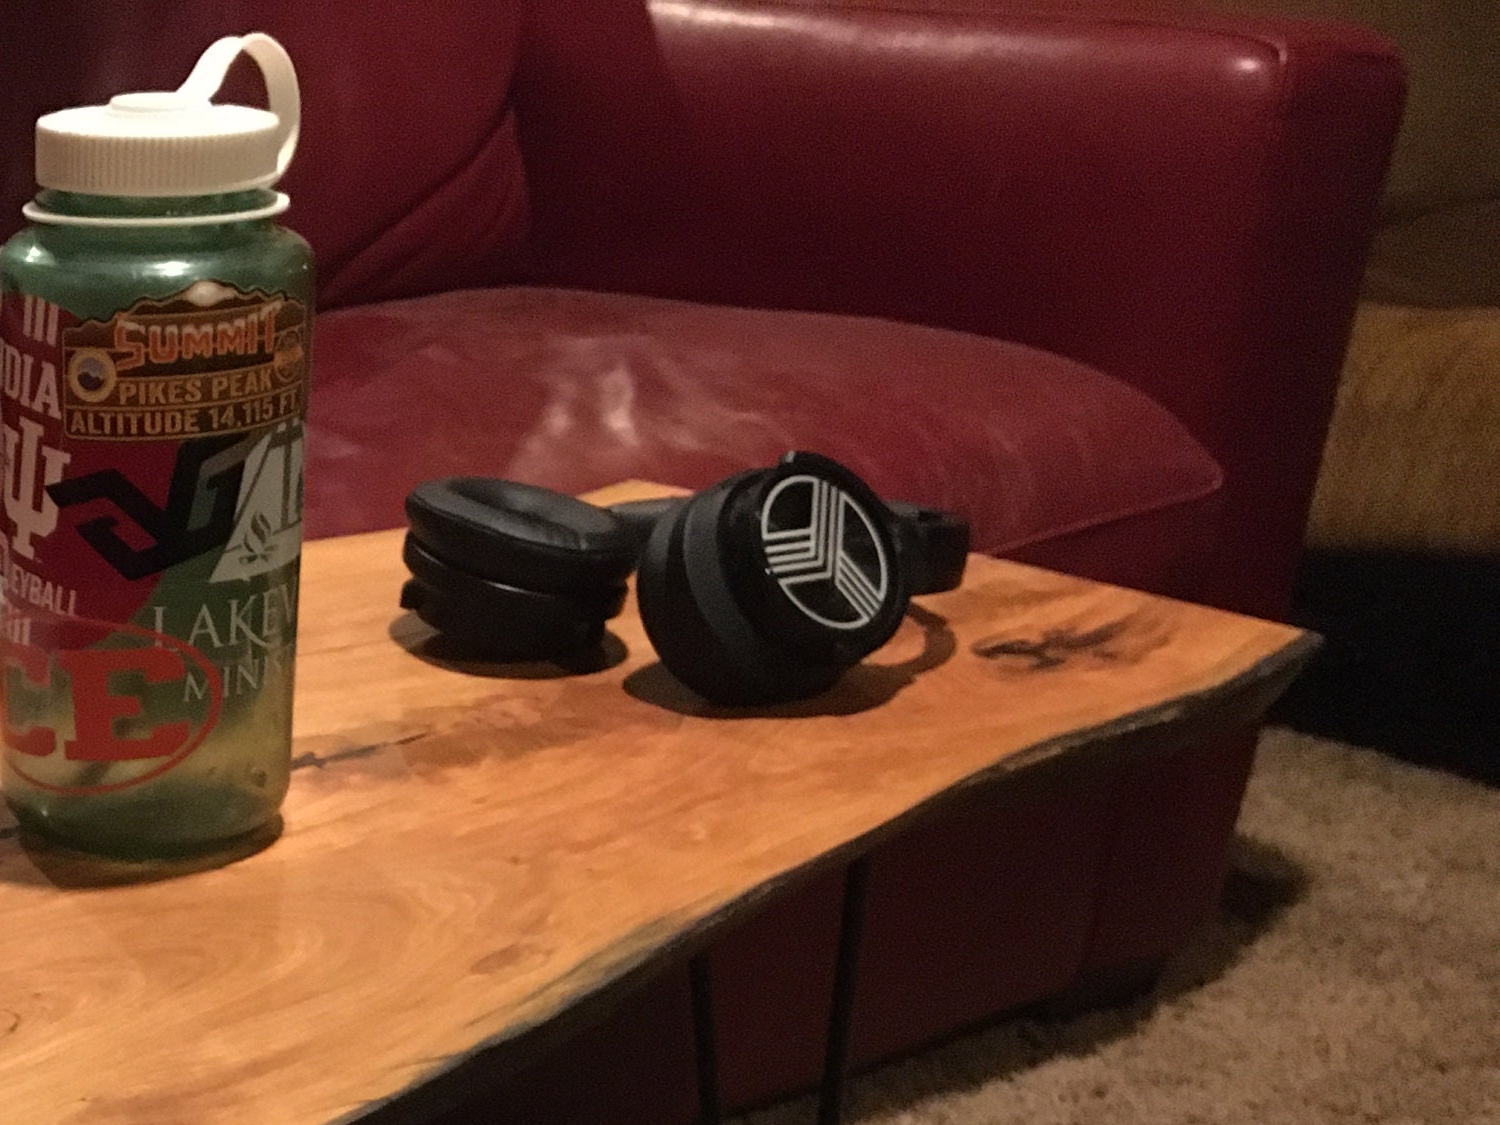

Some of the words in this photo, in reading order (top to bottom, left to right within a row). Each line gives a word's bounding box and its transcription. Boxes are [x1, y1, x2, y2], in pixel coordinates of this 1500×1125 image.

[113, 301, 283, 371] SUMMIT
[118, 379, 202, 405] PIKES
[211, 366, 273, 400] PEAK
[69, 409, 200, 435] ALTITUDE
[208, 397, 275, 431] 14,115
